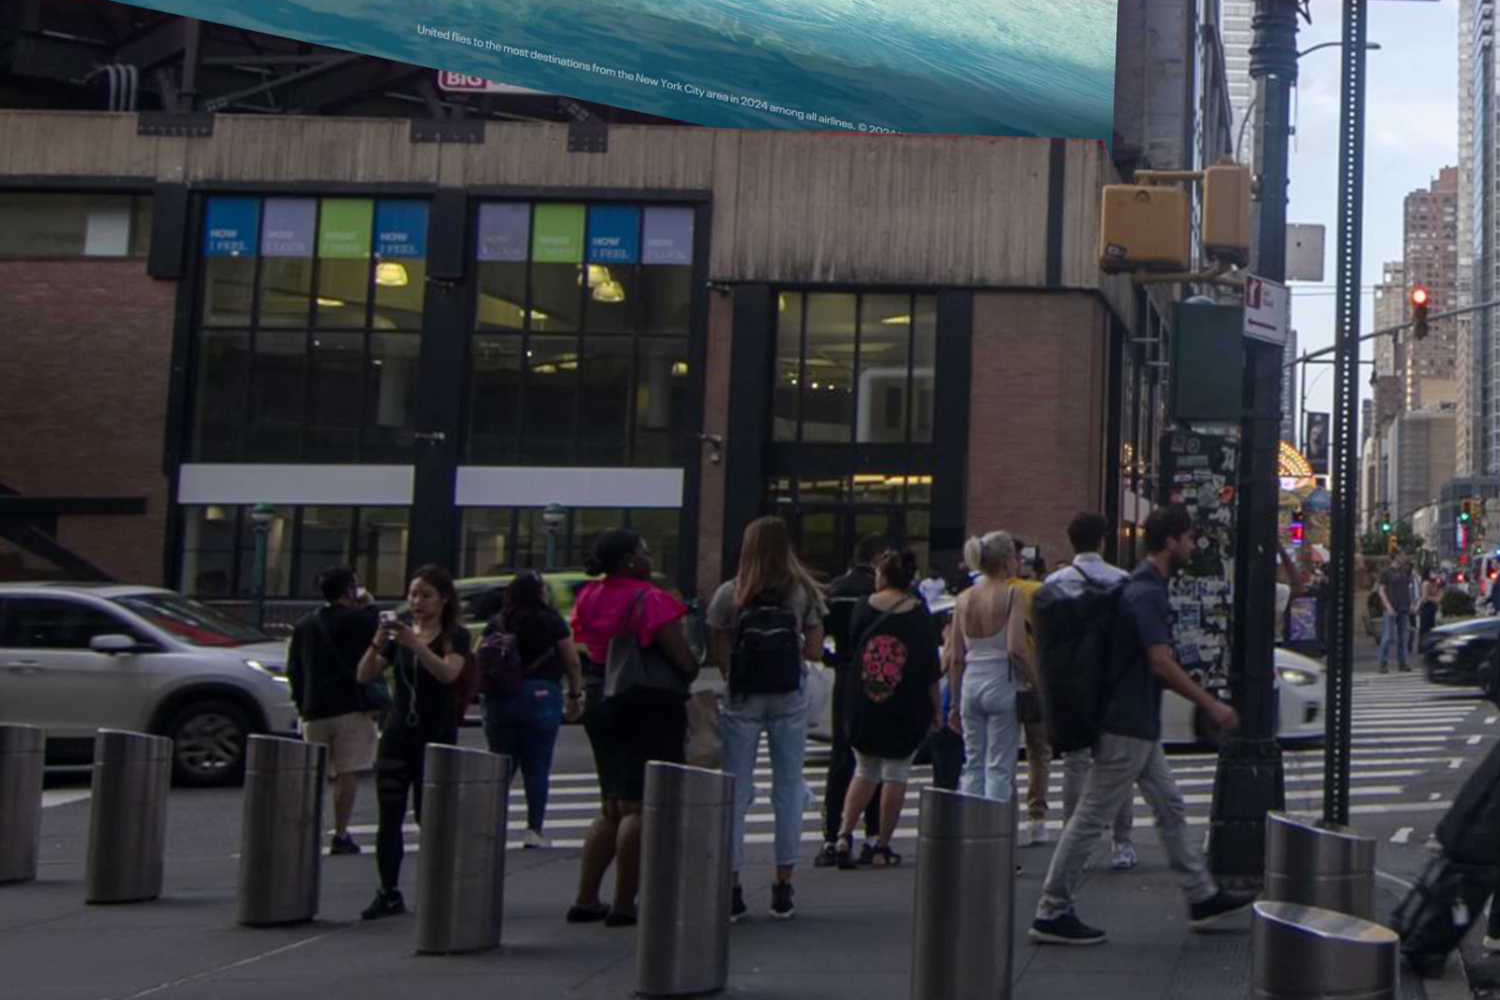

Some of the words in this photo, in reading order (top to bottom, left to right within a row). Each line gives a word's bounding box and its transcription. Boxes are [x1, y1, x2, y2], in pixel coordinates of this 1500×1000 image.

[417, 24, 450, 40] United
[451, 32, 472, 45] flies
[473, 38, 484, 48] to
[485, 40, 502, 52] the
[503, 45, 529, 58] most
[530, 50, 590, 72] destinations
[592, 63, 616, 77] from
[617, 70, 635, 81] the
[635, 73, 659, 86] New
[660, 78, 683, 92] York
[684, 84, 706, 99] City
[706, 90, 729, 102] area
[730, 94, 740, 104] in
[741, 96, 768, 110] 2024
[769, 103, 805, 120] among
[806, 112, 817, 121] all
[818, 115, 856, 131] airlines.
